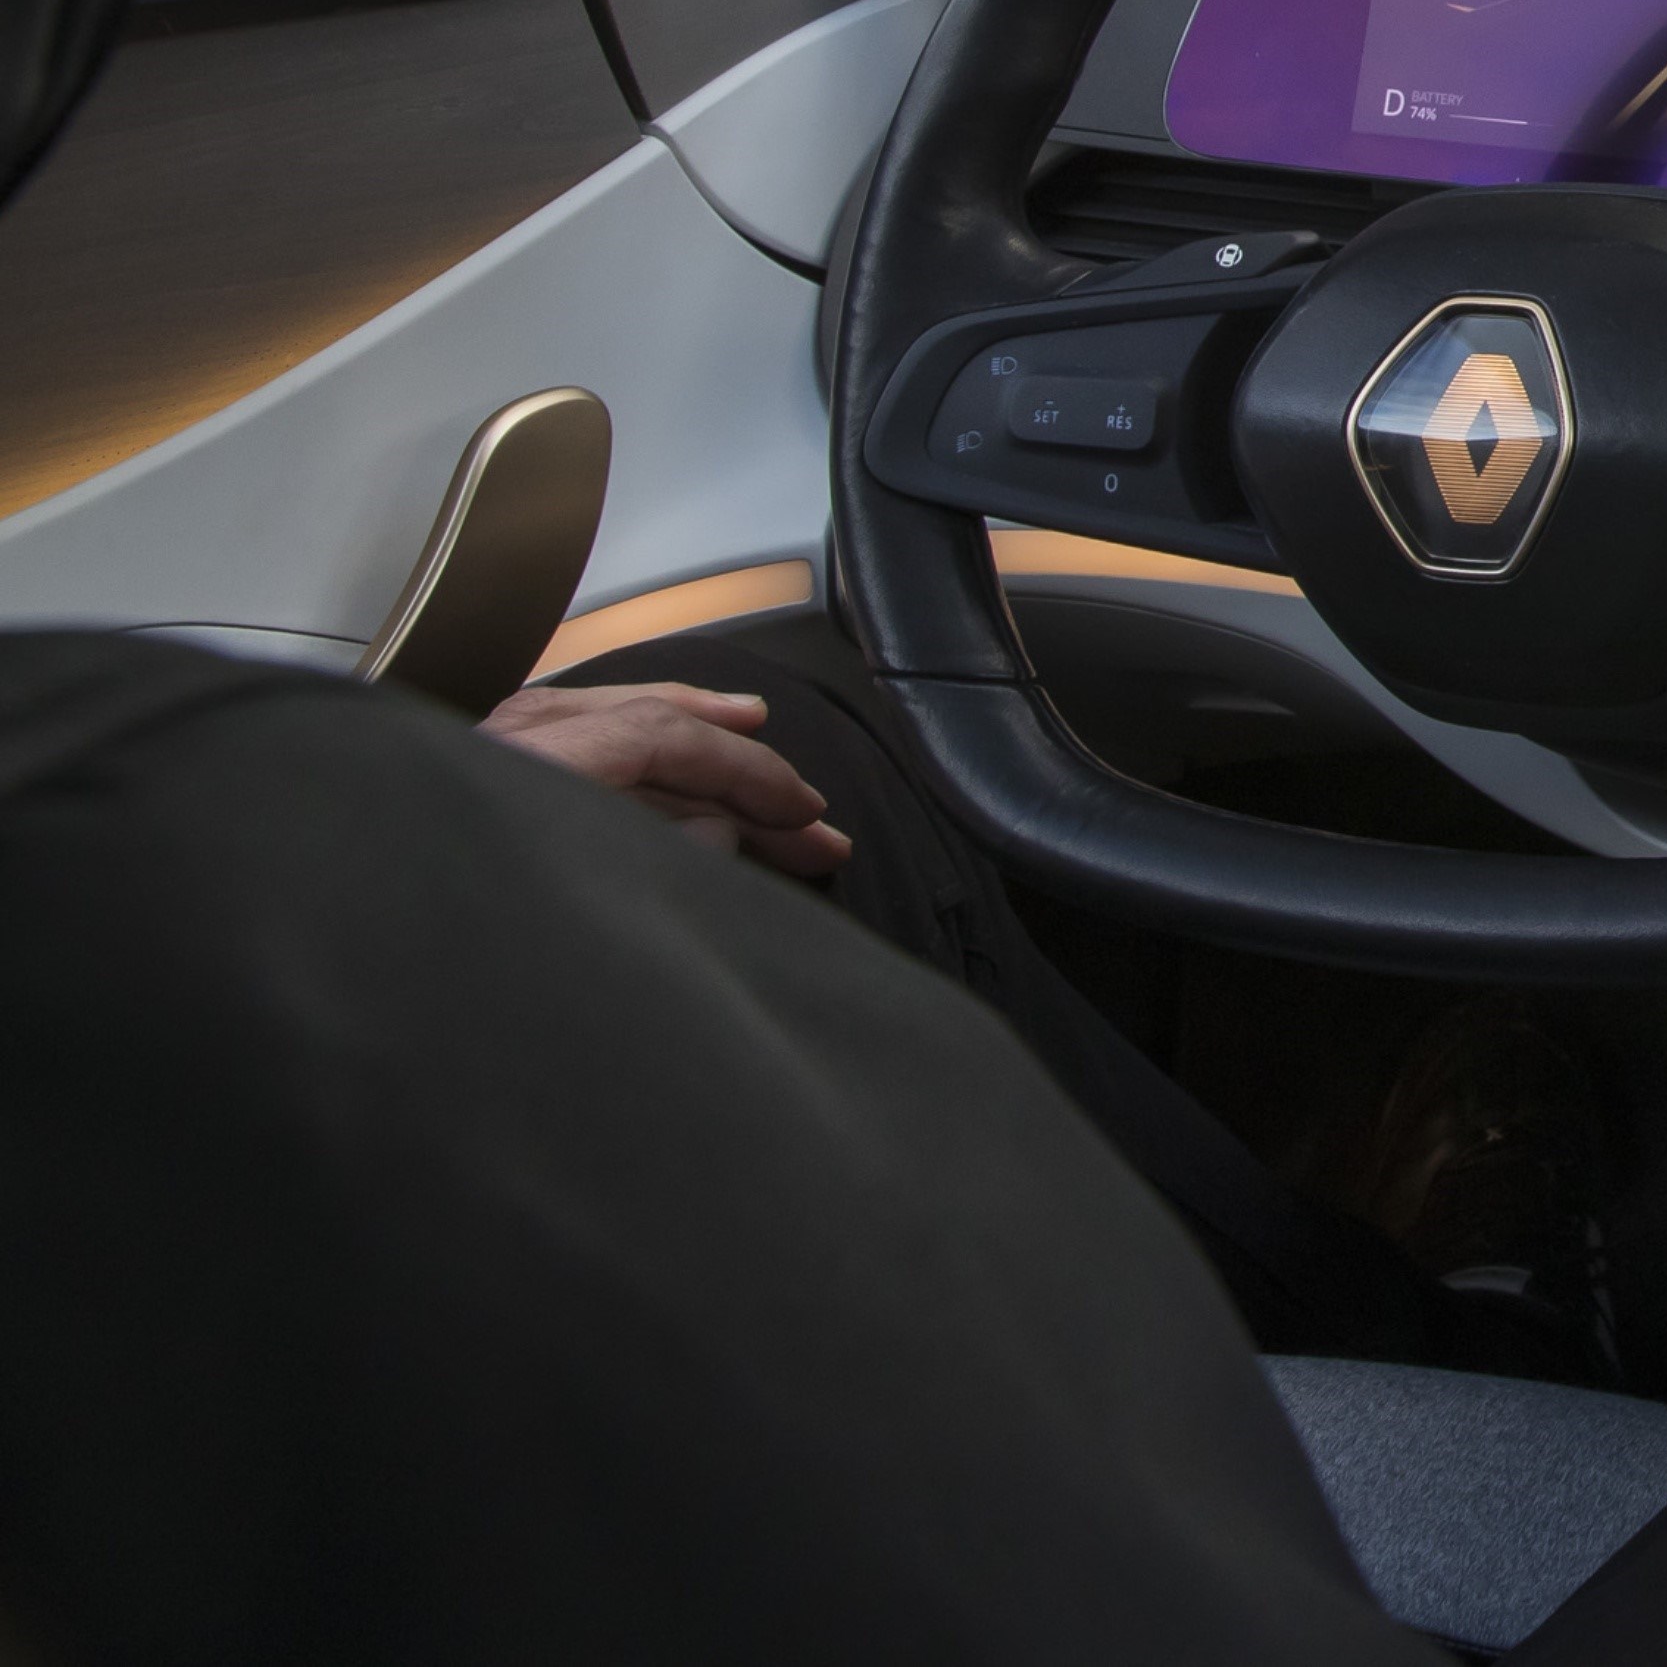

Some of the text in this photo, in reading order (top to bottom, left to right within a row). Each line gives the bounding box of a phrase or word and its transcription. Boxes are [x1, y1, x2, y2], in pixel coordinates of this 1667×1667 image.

[1383, 88, 1405, 117] D
[1410, 89, 1464, 107] BATTERY
[1409, 105, 1437, 121] 74%
[1033, 409, 1060, 423] SET
[1106, 415, 1133, 430] RES
